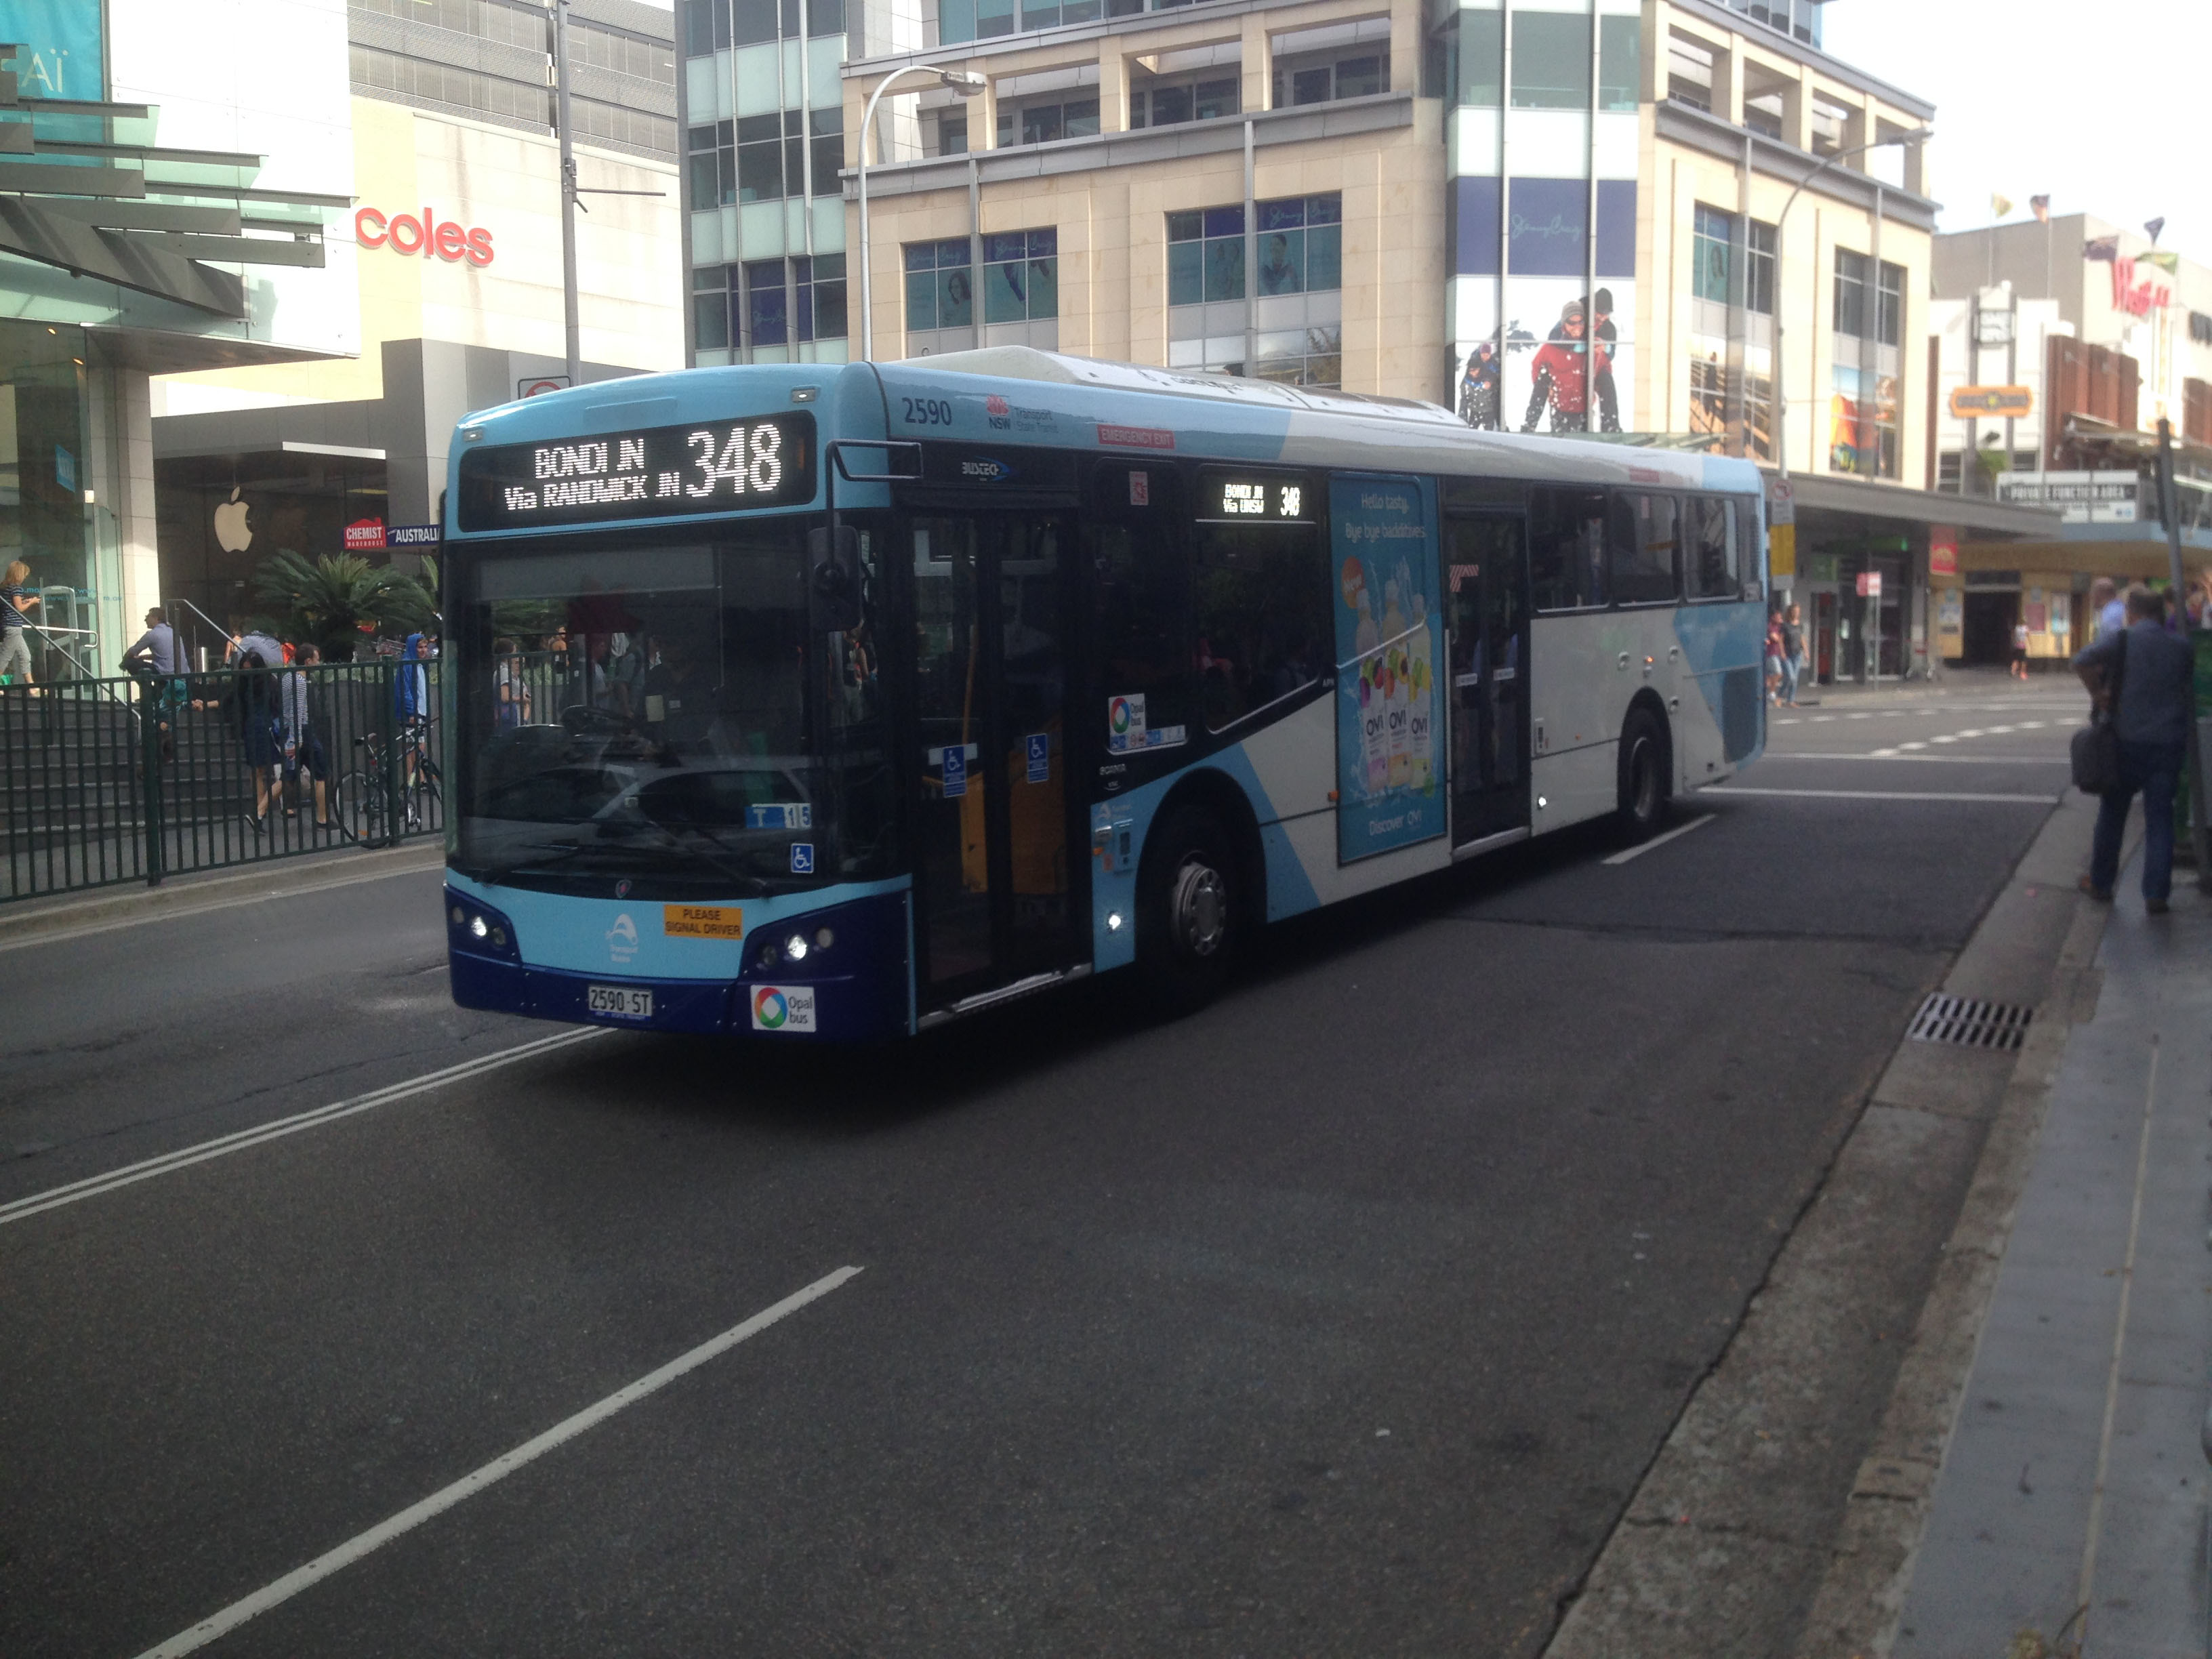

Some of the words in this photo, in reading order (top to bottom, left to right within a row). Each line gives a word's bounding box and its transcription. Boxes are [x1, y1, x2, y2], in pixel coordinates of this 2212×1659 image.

[355, 207, 494, 267] coles
[902, 397, 951, 426] 2590
[988, 416, 1010, 430] NSW
[1101, 428, 1152, 445] EMERGENCY
[1154, 433, 1170, 446] EXIT
[535, 443, 607, 478] BONDI
[617, 438, 644, 471] JN
[686, 424, 781, 497] 348
[504, 487, 537, 510] Via
[544, 475, 649, 508] RANDWICK
[655, 472, 680, 497] JN
[1225, 484, 1251, 498] BONDI
[1279, 487, 1300, 516] 348
[1361, 493, 1383, 510] Hello
[346, 527, 382, 540] CHEMIST
[1345, 523, 1361, 543] Bye
[1364, 522, 1380, 543] bye
[1366, 714, 1383, 736] OVI
[1389, 710, 1407, 729] OVI
[1412, 718, 1428, 734] OVI
[1370, 816, 1404, 836] Discover
[682, 909, 721, 920] PLEASE
[664, 921, 701, 933] SIGNAL
[703, 924, 741, 935] DRIVER
[590, 989, 625, 1011] 2590
[632, 993, 649, 1014] ST
[788, 996, 813, 1010] Opal
[790, 1010, 808, 1024] bus
